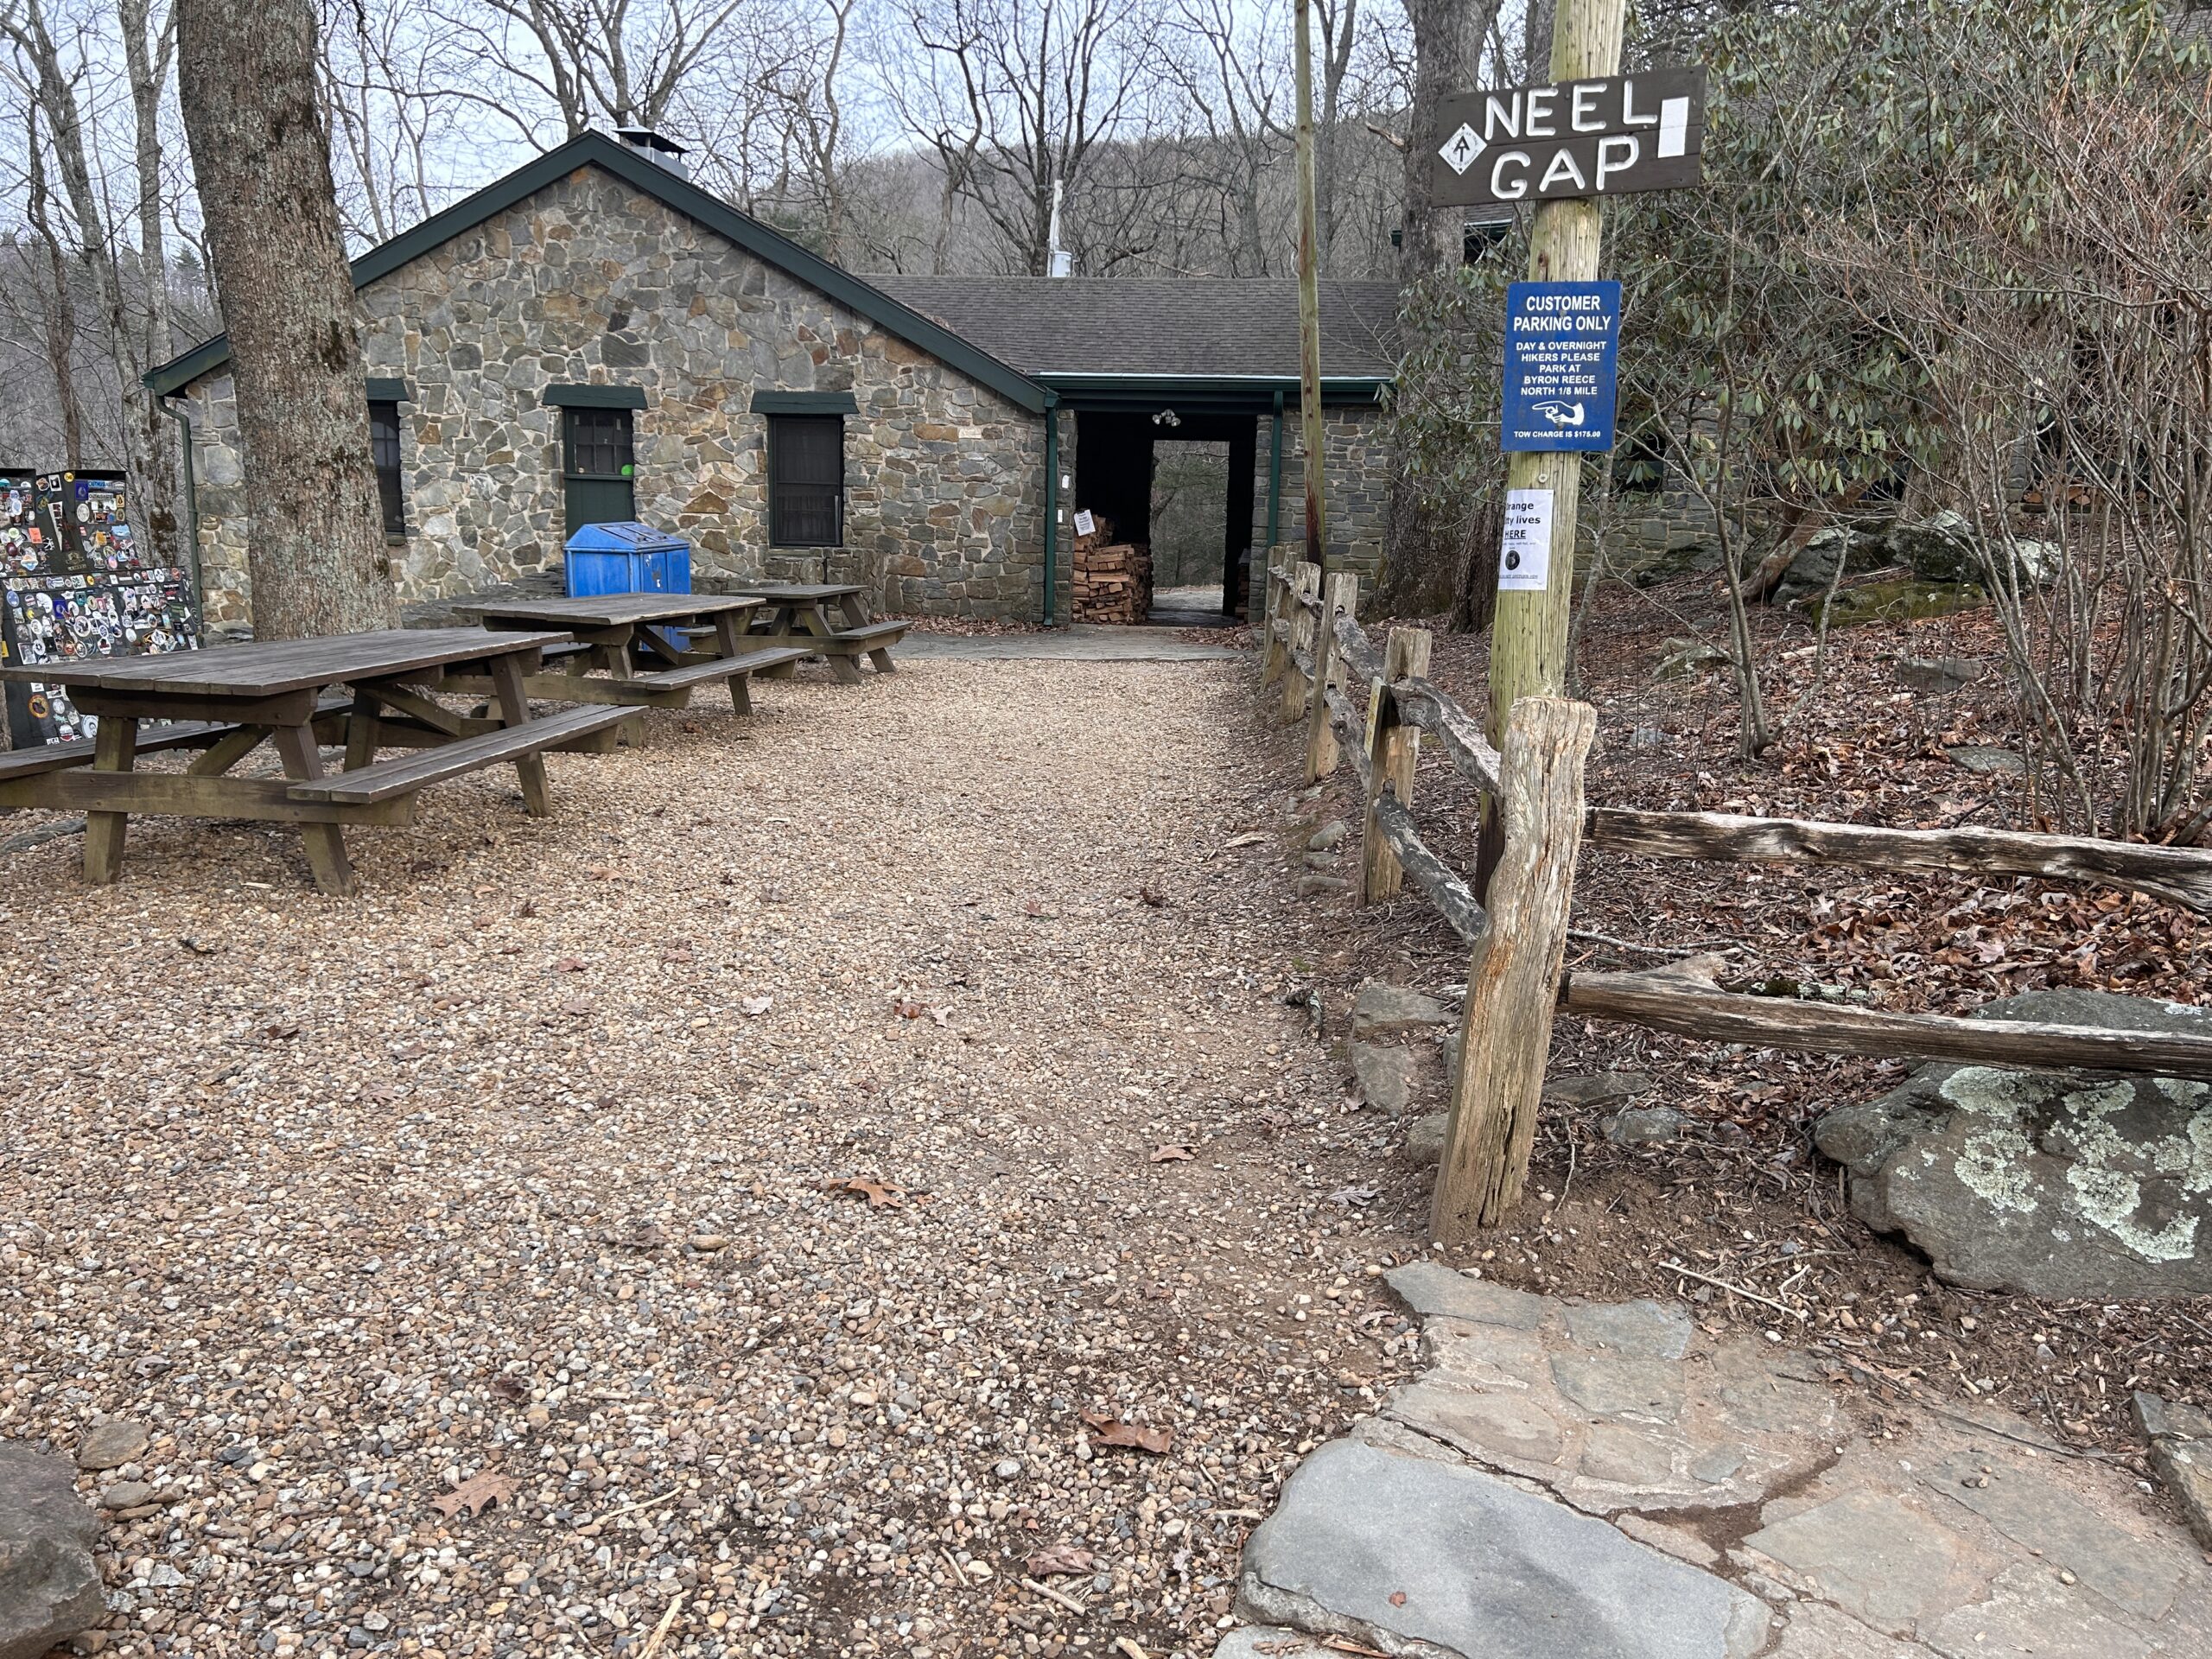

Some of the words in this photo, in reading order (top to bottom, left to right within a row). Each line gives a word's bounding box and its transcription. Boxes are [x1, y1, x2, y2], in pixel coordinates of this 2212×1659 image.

[1484, 79, 1658, 141] NEEL
[1491, 135, 1640, 200] GAP
[1526, 296, 1601, 311] CUSTOMER
[1513, 316, 1573, 332] PARKING
[1575, 315, 1611, 331] ONLY
[1516, 342, 1536, 351] DAY
[1538, 342, 1546, 351] &
[1548, 341, 1607, 351] OVERNIGHT
[1521, 353, 1559, 362] HIKERS
[1560, 353, 1600, 361] PLEASE
[1539, 364, 1567, 373] PARK
[1568, 364, 1581, 372] AT
[1523, 376, 1560, 385] BYRON
[1561, 375, 1596, 384] REECE
[1521, 387, 1556, 396] NORTH
[1558, 386, 1572, 395] 1/8
[1573, 386, 1598, 395] MILE
[1516, 515, 1541, 524] lives
[1504, 529, 1527, 539] HERE
